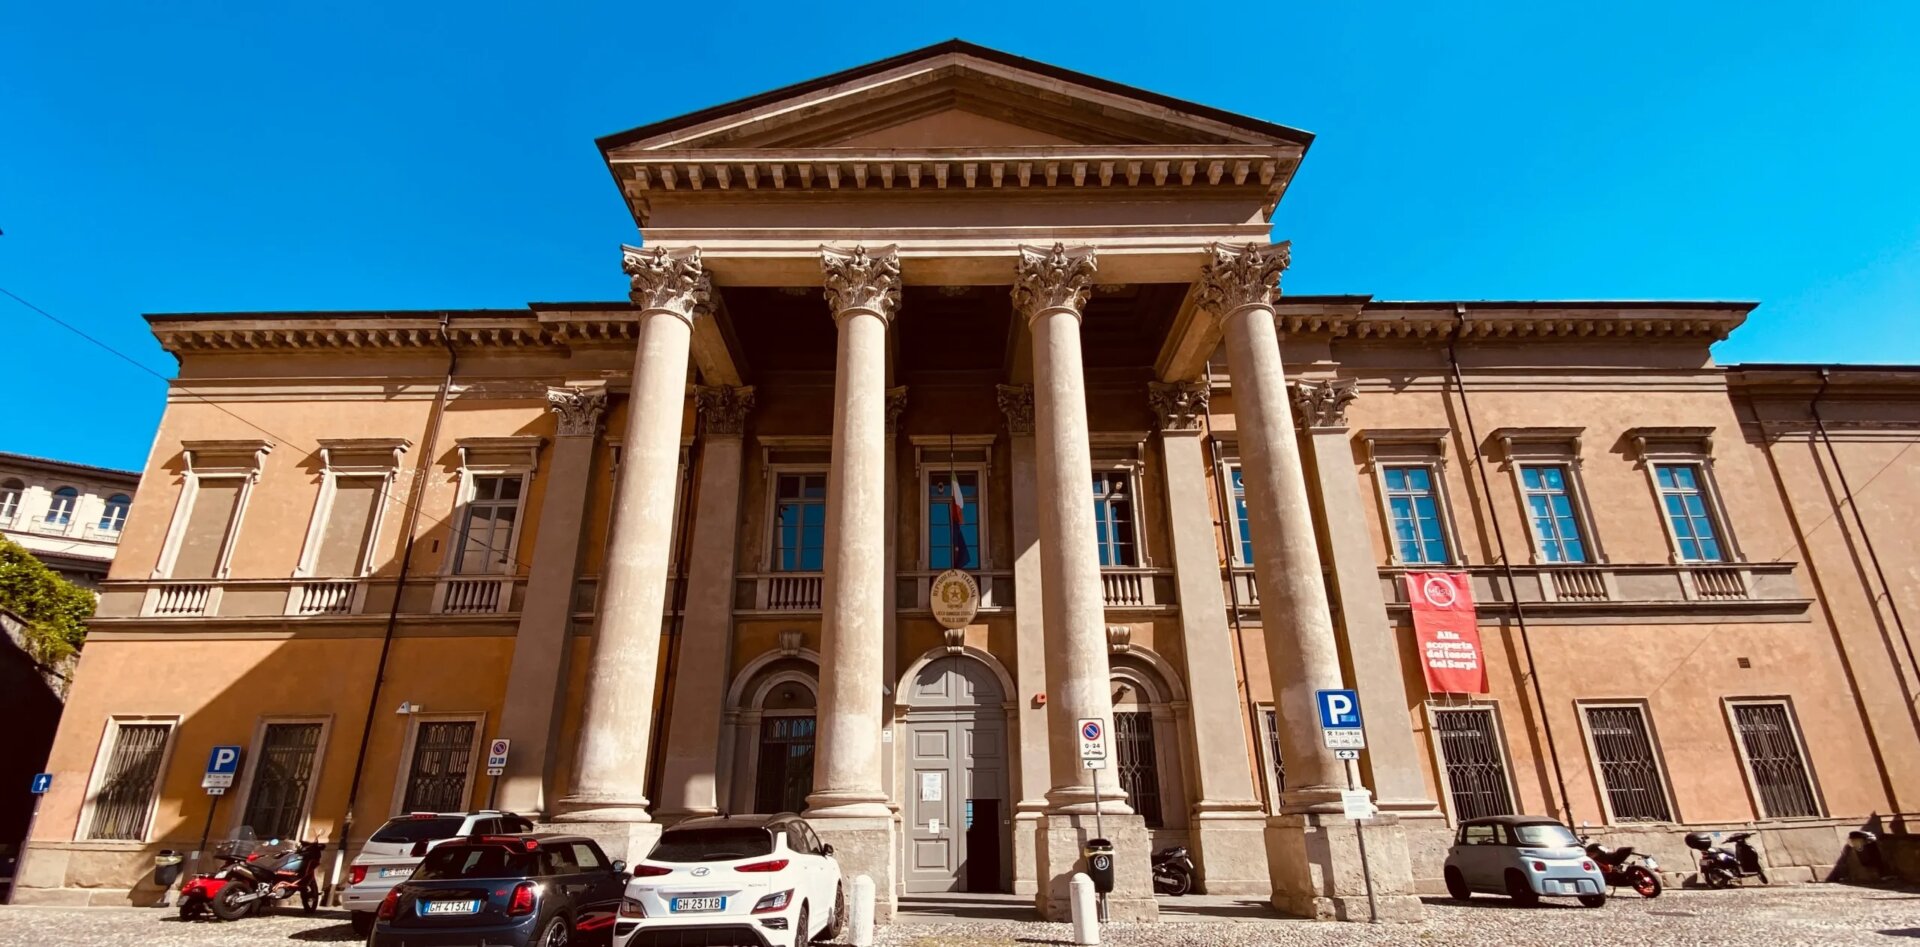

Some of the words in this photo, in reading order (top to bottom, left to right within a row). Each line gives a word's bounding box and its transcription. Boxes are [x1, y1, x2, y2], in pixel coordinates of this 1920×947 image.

[1436, 630, 1460, 640] Alla
[1426, 641, 1474, 650] scoperta
[1427, 649, 1445, 658] dei
[1445, 649, 1477, 659] tesori
[1429, 659, 1447, 668] del
[1448, 659, 1478, 670] Sarpi
[1327, 694, 1352, 725] P
[214, 749, 235, 770] P
[691, 898, 720, 909] 231XB
